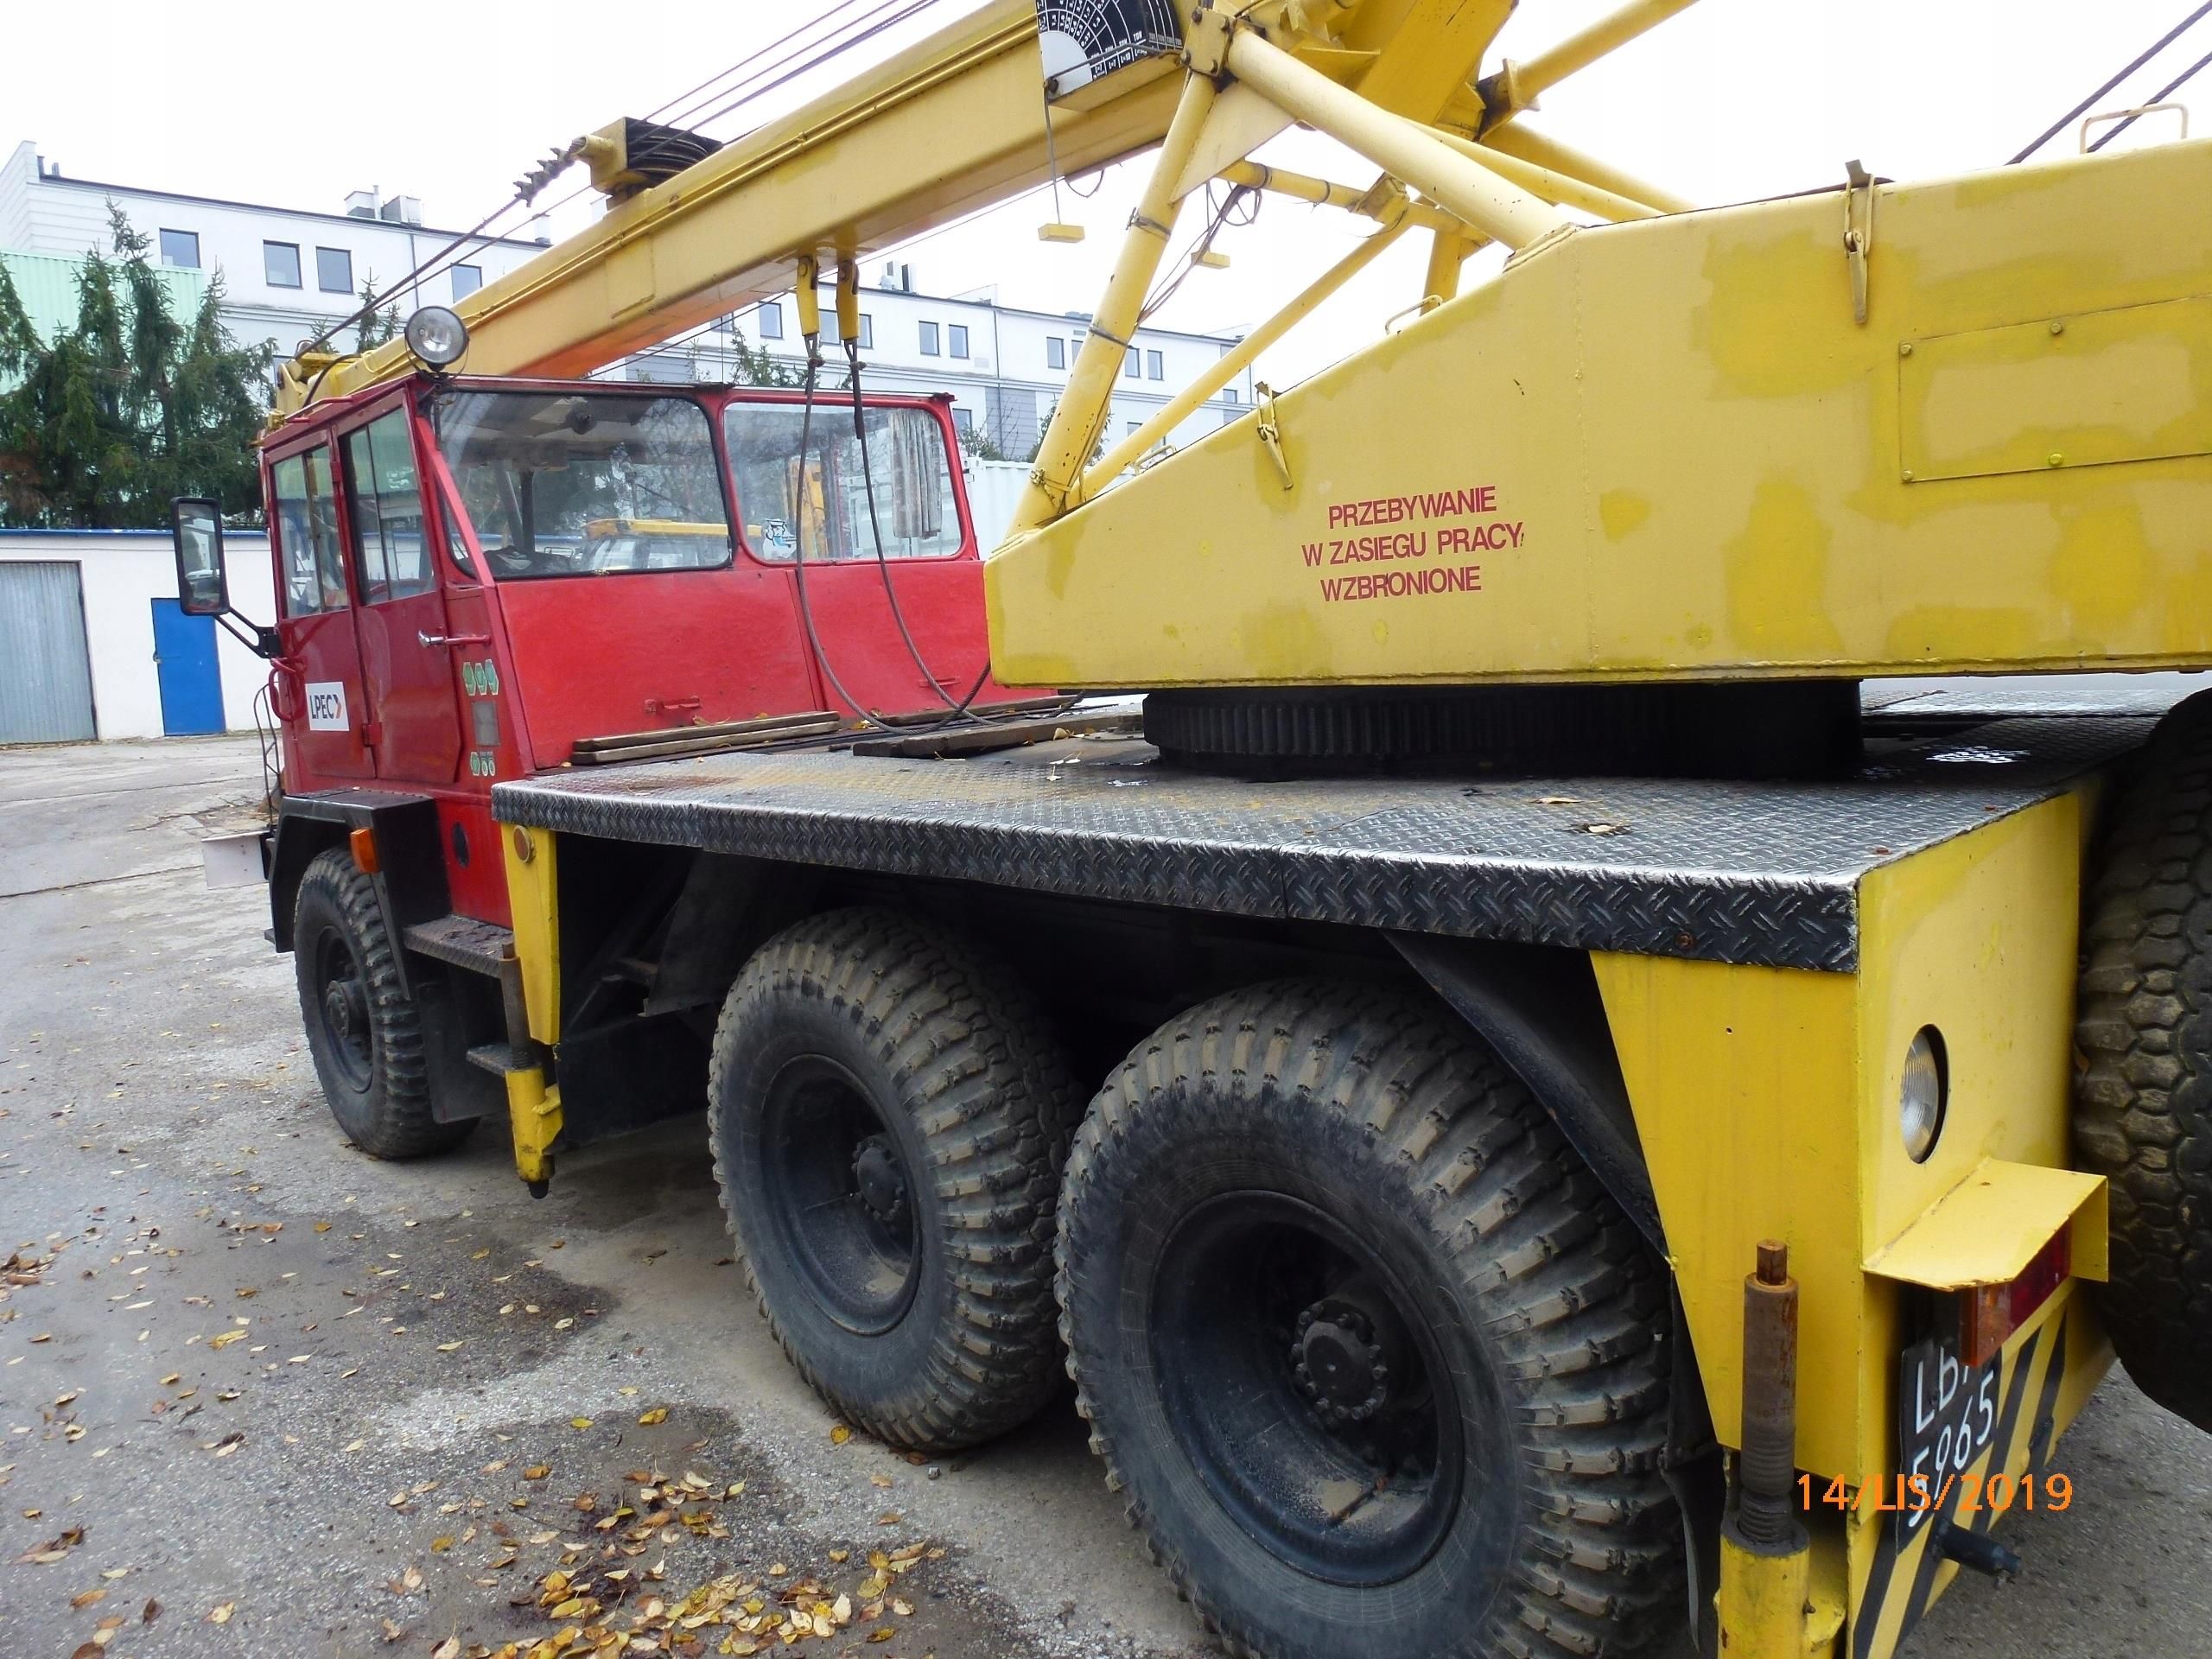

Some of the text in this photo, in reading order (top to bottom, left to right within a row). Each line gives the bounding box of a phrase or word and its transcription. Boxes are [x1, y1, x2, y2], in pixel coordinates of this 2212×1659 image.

[1328, 486, 1497, 529] PRZEBYWANIE
[1301, 522, 1522, 567] W ZASIEGU PRACY
[1320, 566, 1482, 602] WZBRONIONE
[309, 694, 334, 719] LPEC
